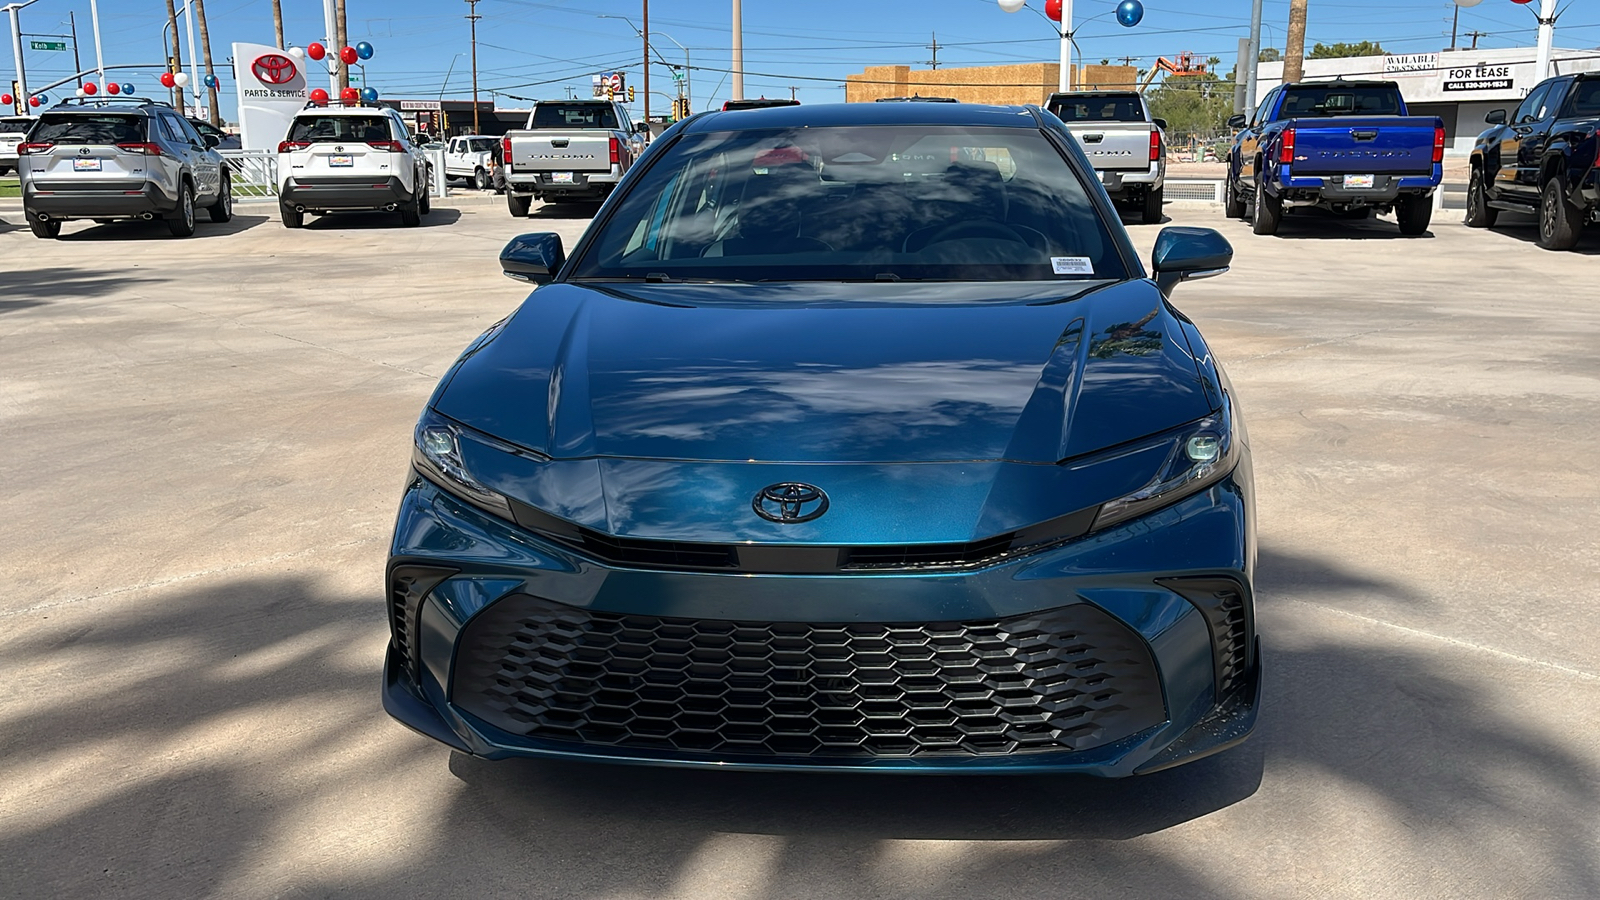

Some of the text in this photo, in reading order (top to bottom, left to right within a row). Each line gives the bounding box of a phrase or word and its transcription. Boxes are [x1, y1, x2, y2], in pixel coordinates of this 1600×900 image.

[1385, 54, 1438, 64] AVAILABLE
[1449, 67, 1509, 79] FOR LEASE
[244, 89, 269, 97] PARTS
[270, 89, 275, 97] &
